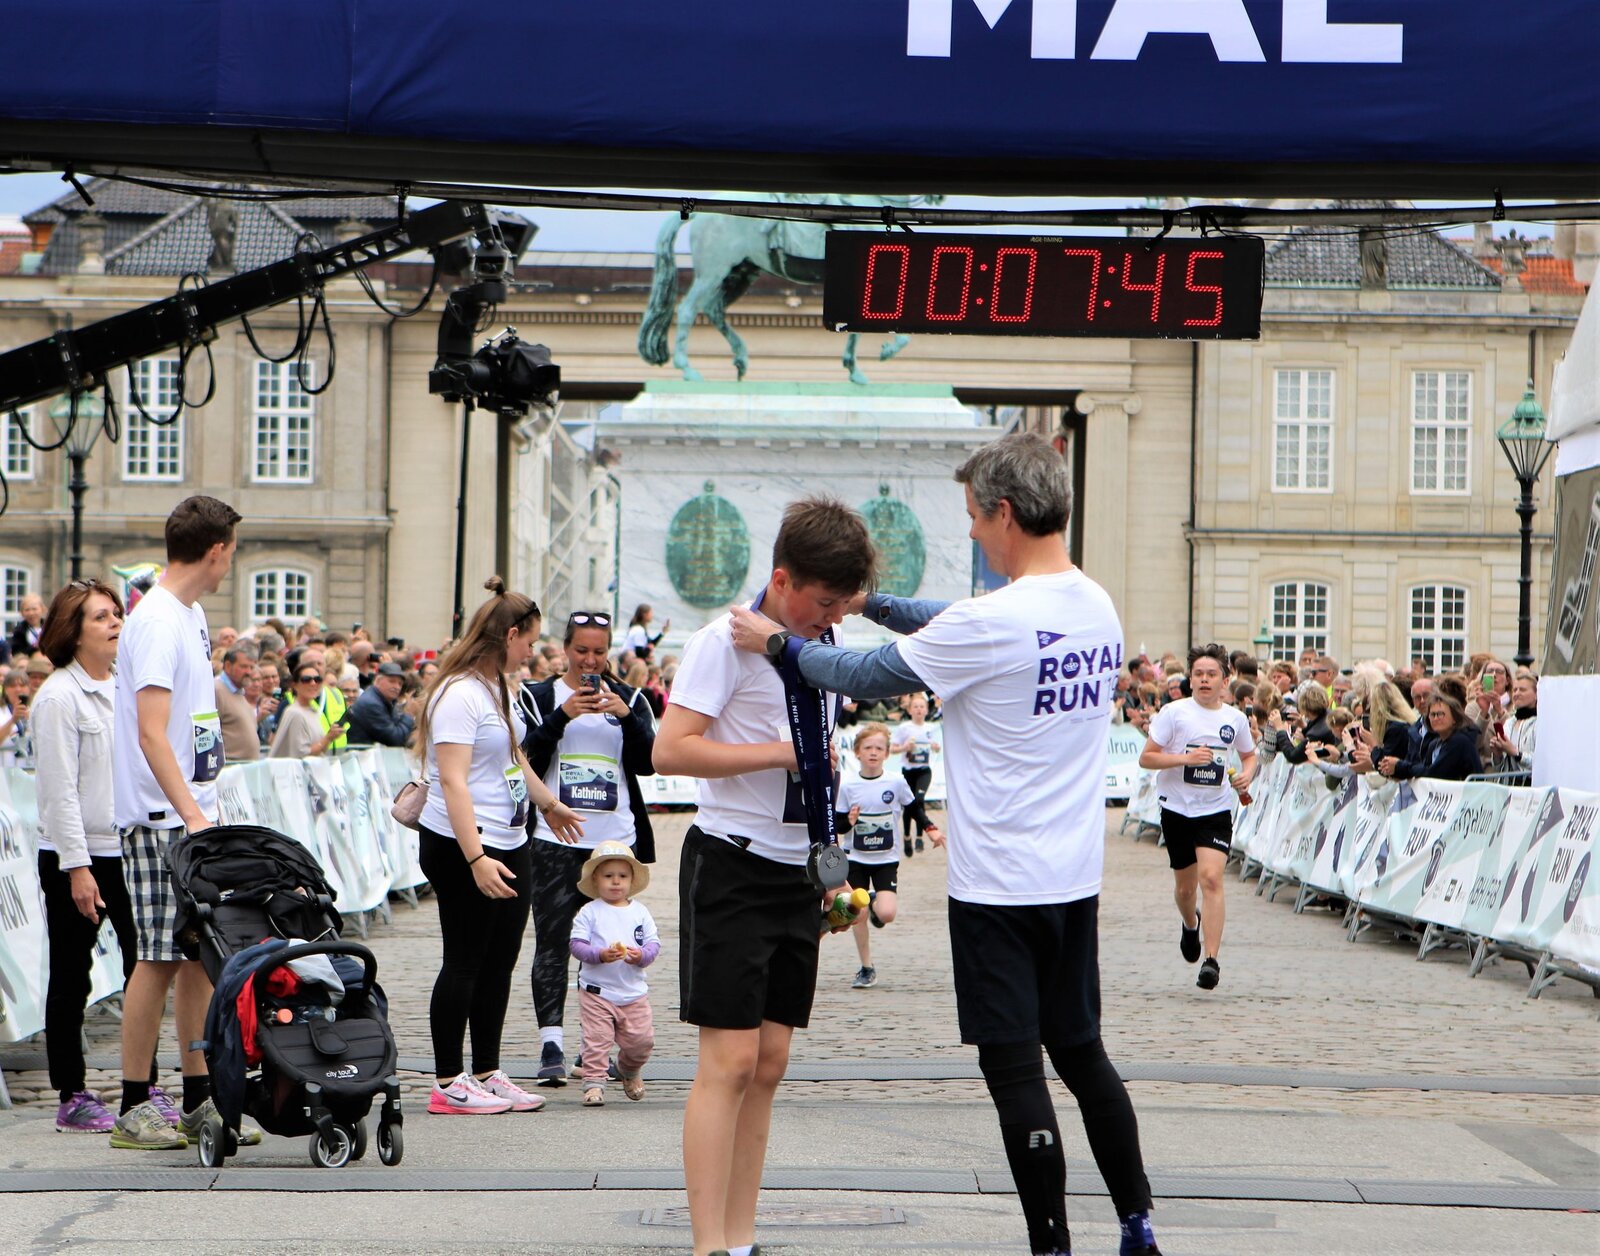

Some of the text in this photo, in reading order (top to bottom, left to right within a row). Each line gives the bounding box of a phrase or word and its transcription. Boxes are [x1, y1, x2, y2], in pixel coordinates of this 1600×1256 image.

[862, 244, 1225, 327] 00:07:45
[1037, 643, 1122, 684] ROYAL
[1033, 680, 1100, 716] RUN
[1108, 738, 1138, 754] lrun
[1193, 769, 1217, 780] Antonio
[571, 785, 608, 801] Kathrine
[1418, 791, 1453, 823] ROYAL
[826, 803, 835, 833] ROYAL
[1562, 804, 1599, 842] ROYAL
[863, 835, 884, 846] Gustav
[1402, 826, 1432, 857] RUN
[1549, 847, 1575, 884] RUN
